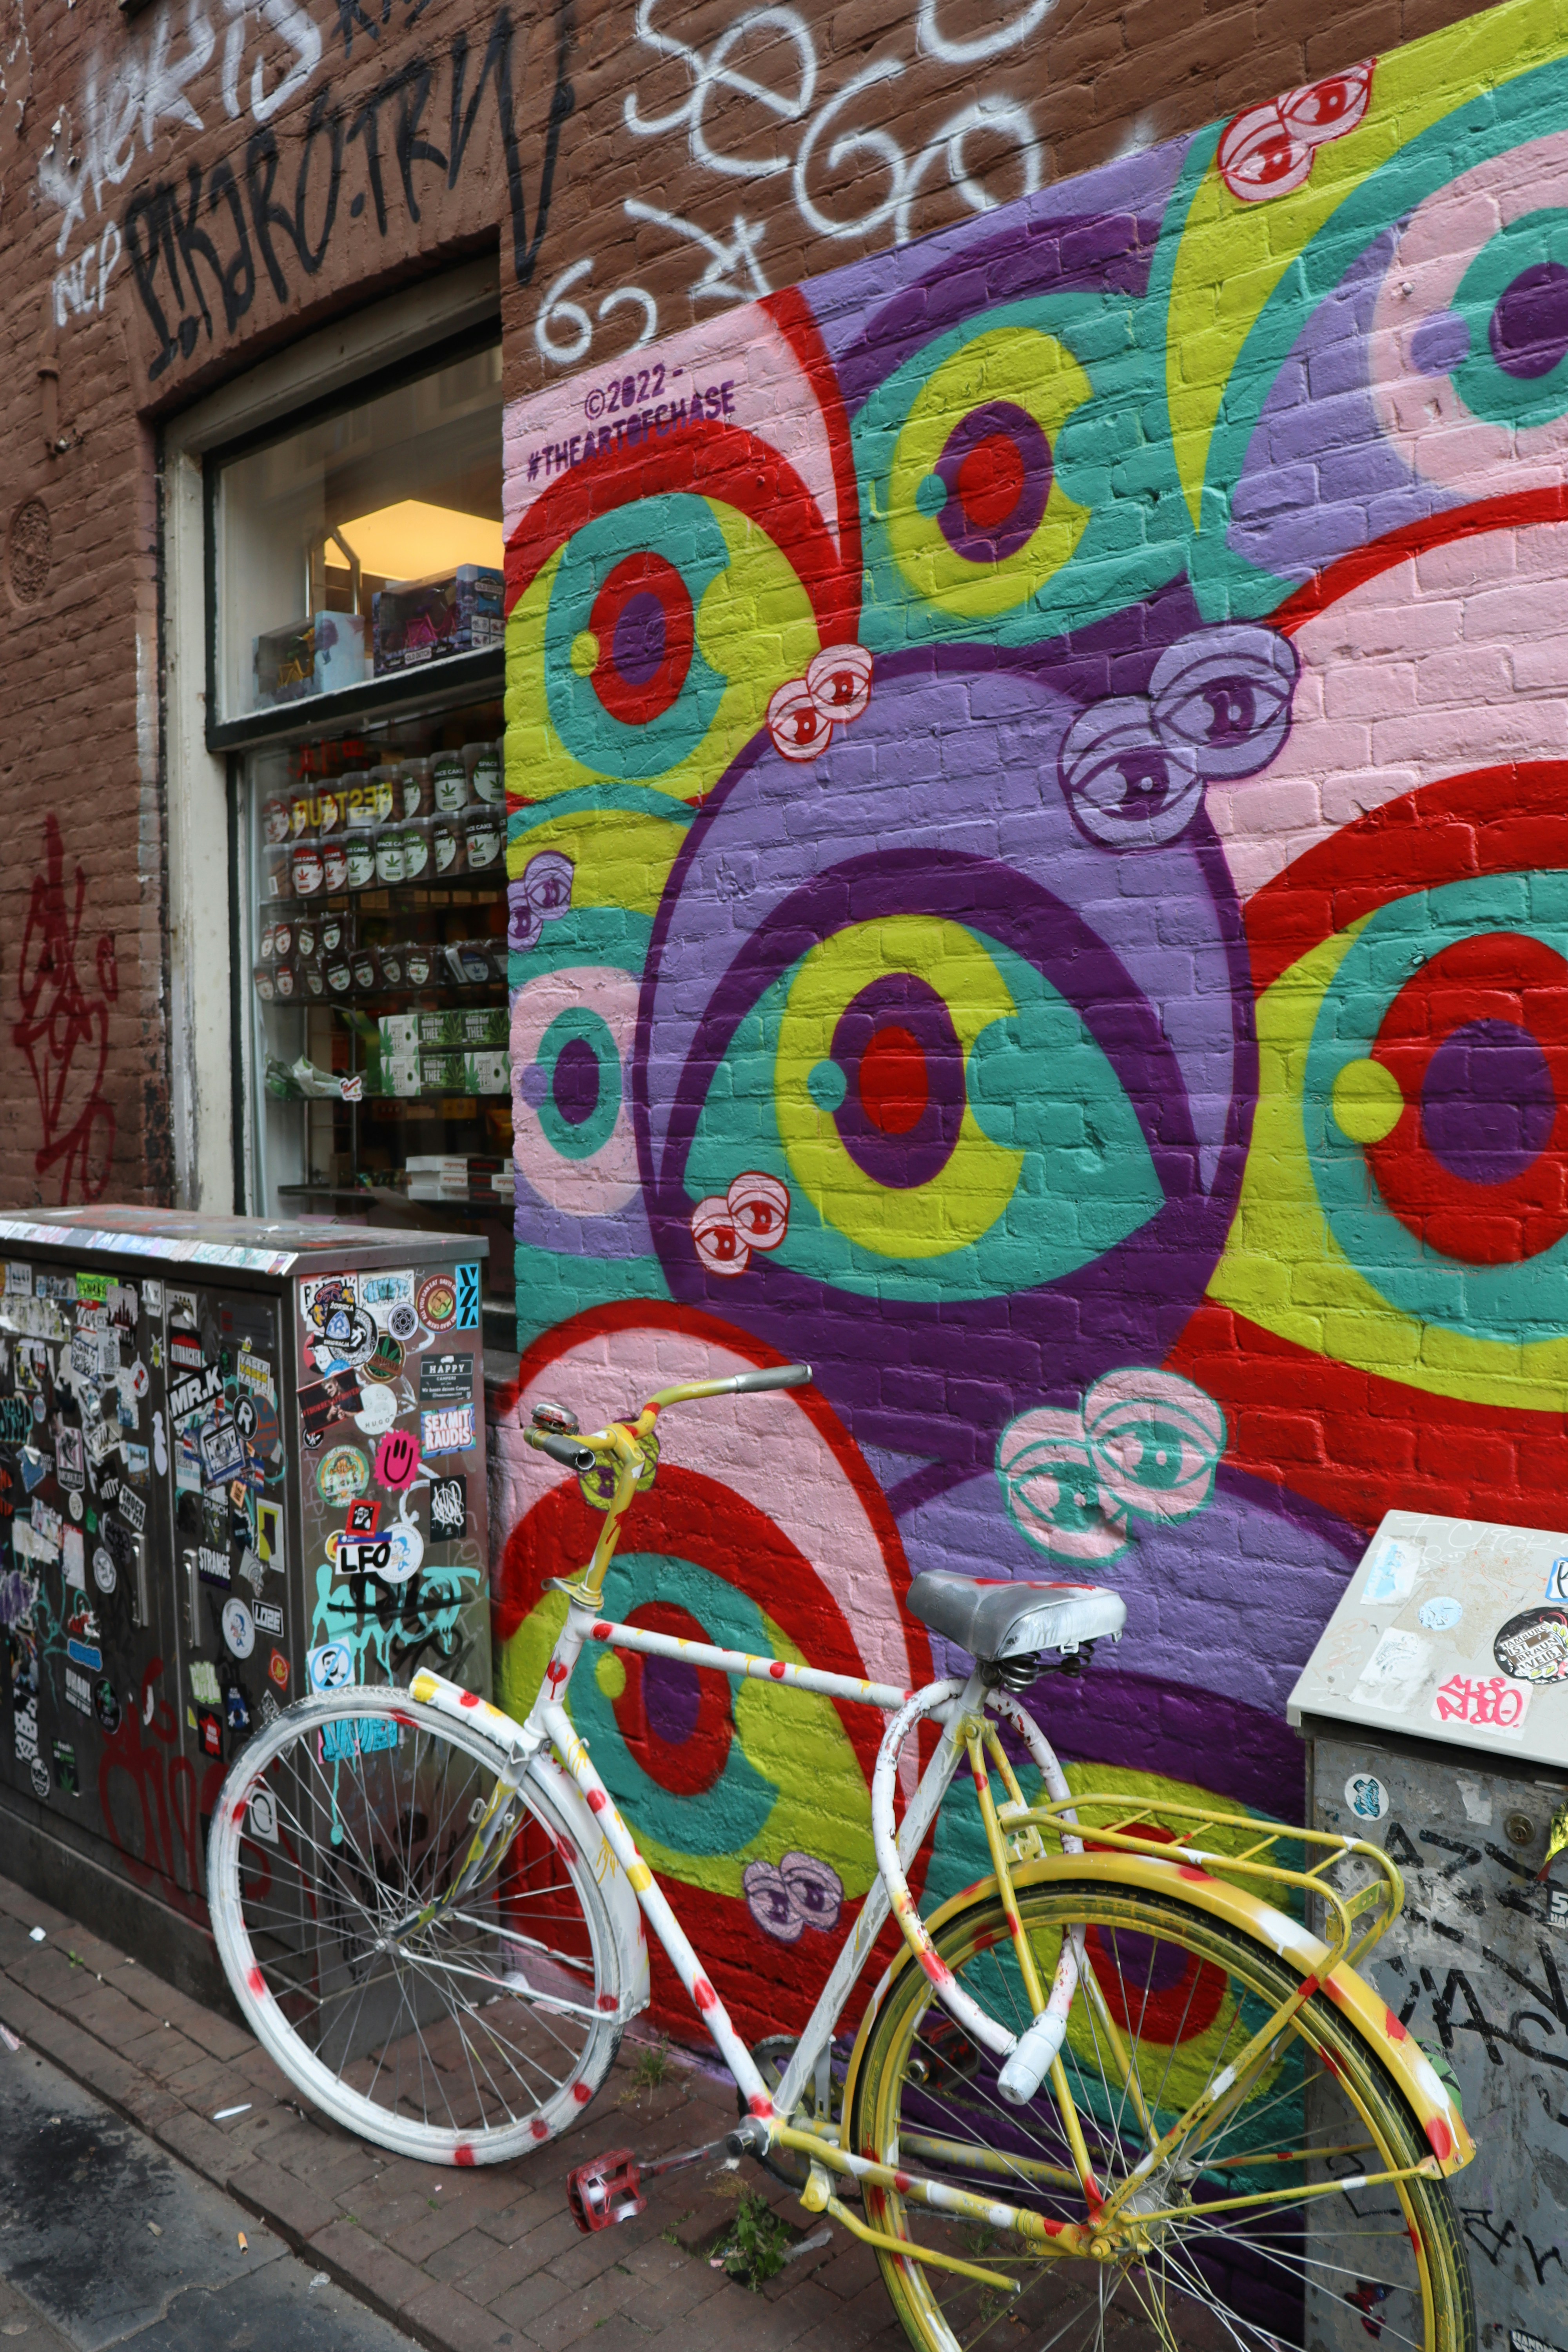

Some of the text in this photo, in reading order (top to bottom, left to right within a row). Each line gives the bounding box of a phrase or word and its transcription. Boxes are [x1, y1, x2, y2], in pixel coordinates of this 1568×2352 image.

[527, 380, 735, 481] #THEARTOFCHASE
[422, 1027, 439, 1039] THEE
[466, 1025, 484, 1038] THEE
[425, 1069, 441, 1082] THEE
[422, 1285, 430, 1297] CAN
[429, 1279, 438, 1289] EAT
[330, 1301, 354, 1311] ŻORSKA
[240, 1354, 269, 1372] YASER
[429, 1364, 465, 1374] HAPPY
[239, 1363, 268, 1384] YASER
[365, 1417, 390, 1428] HUGO
[425, 1413, 448, 1432] SEX
[198, 1545, 231, 1580] STRANGE
[341, 1542, 391, 1573] LFO
[1508, 1642, 1527, 1656] IST
[1517, 1637, 1557, 1662] BRAUN
